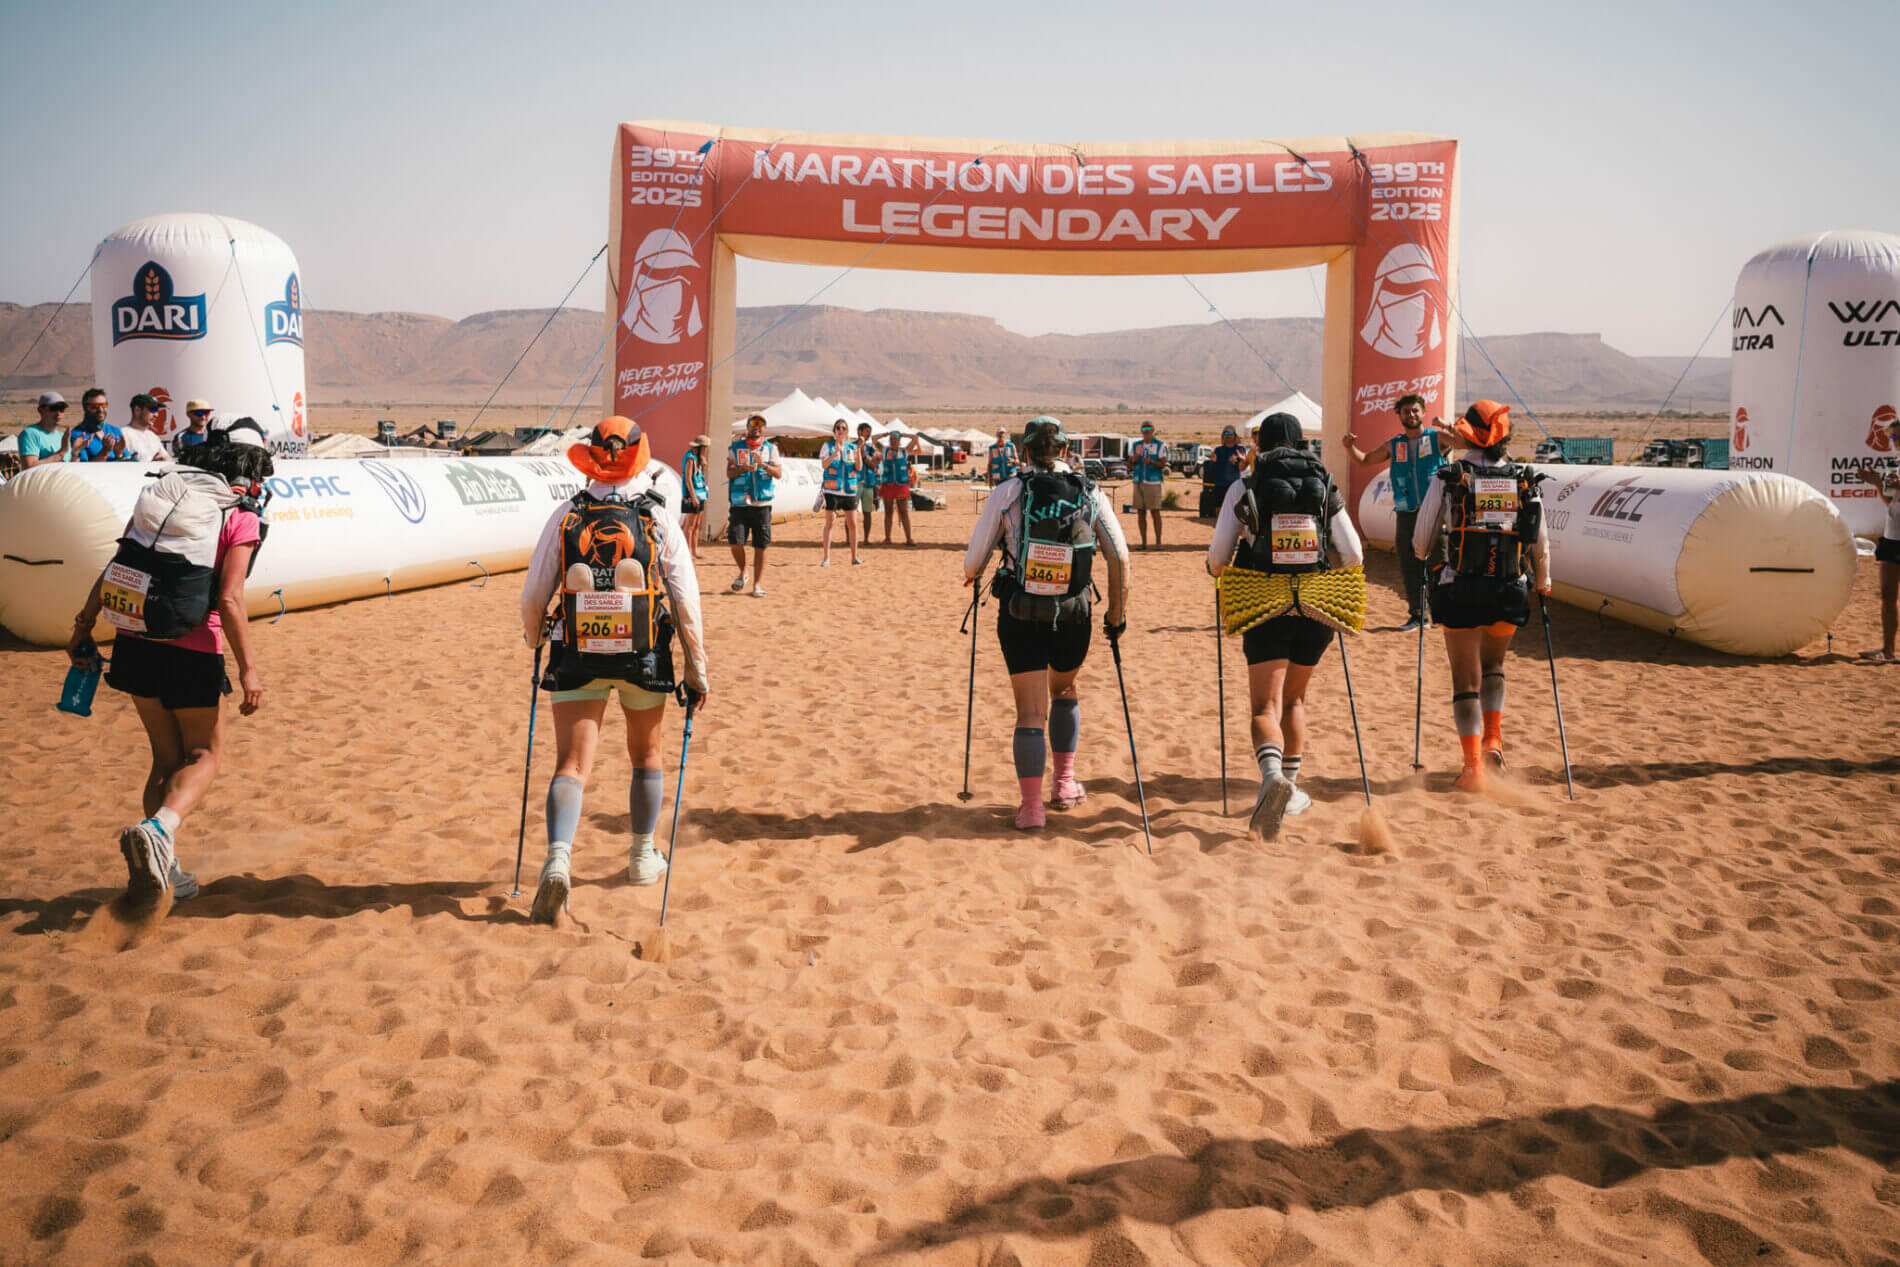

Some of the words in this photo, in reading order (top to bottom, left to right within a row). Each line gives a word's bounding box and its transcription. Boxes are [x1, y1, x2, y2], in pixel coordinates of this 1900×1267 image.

[630, 144, 704, 170] 39TH
[631, 171, 704, 186] EDITION
[752, 150, 1029, 194] MARATHON
[1042, 163, 1135, 195] DES
[1147, 160, 1333, 195] SABLES
[1370, 161, 1446, 184] 39TH
[630, 186, 703, 207] 2025
[1371, 186, 1444, 199] EDITION
[842, 198, 1241, 242] LEGENDARY
[1370, 202, 1443, 221] 2025
[117, 304, 200, 332] DARI
[617, 365, 664, 385] NEVER
[664, 361, 704, 377] STOP
[621, 375, 698, 400] DREAMING
[1355, 379, 1409, 401] NEVER
[1408, 373, 1443, 392] STOP
[1479, 499, 1502, 510] 283
[1277, 537, 1302, 550] 376
[1030, 567, 1054, 582] 346
[103, 592, 127, 613] 815
[582, 622, 611, 637] 206
